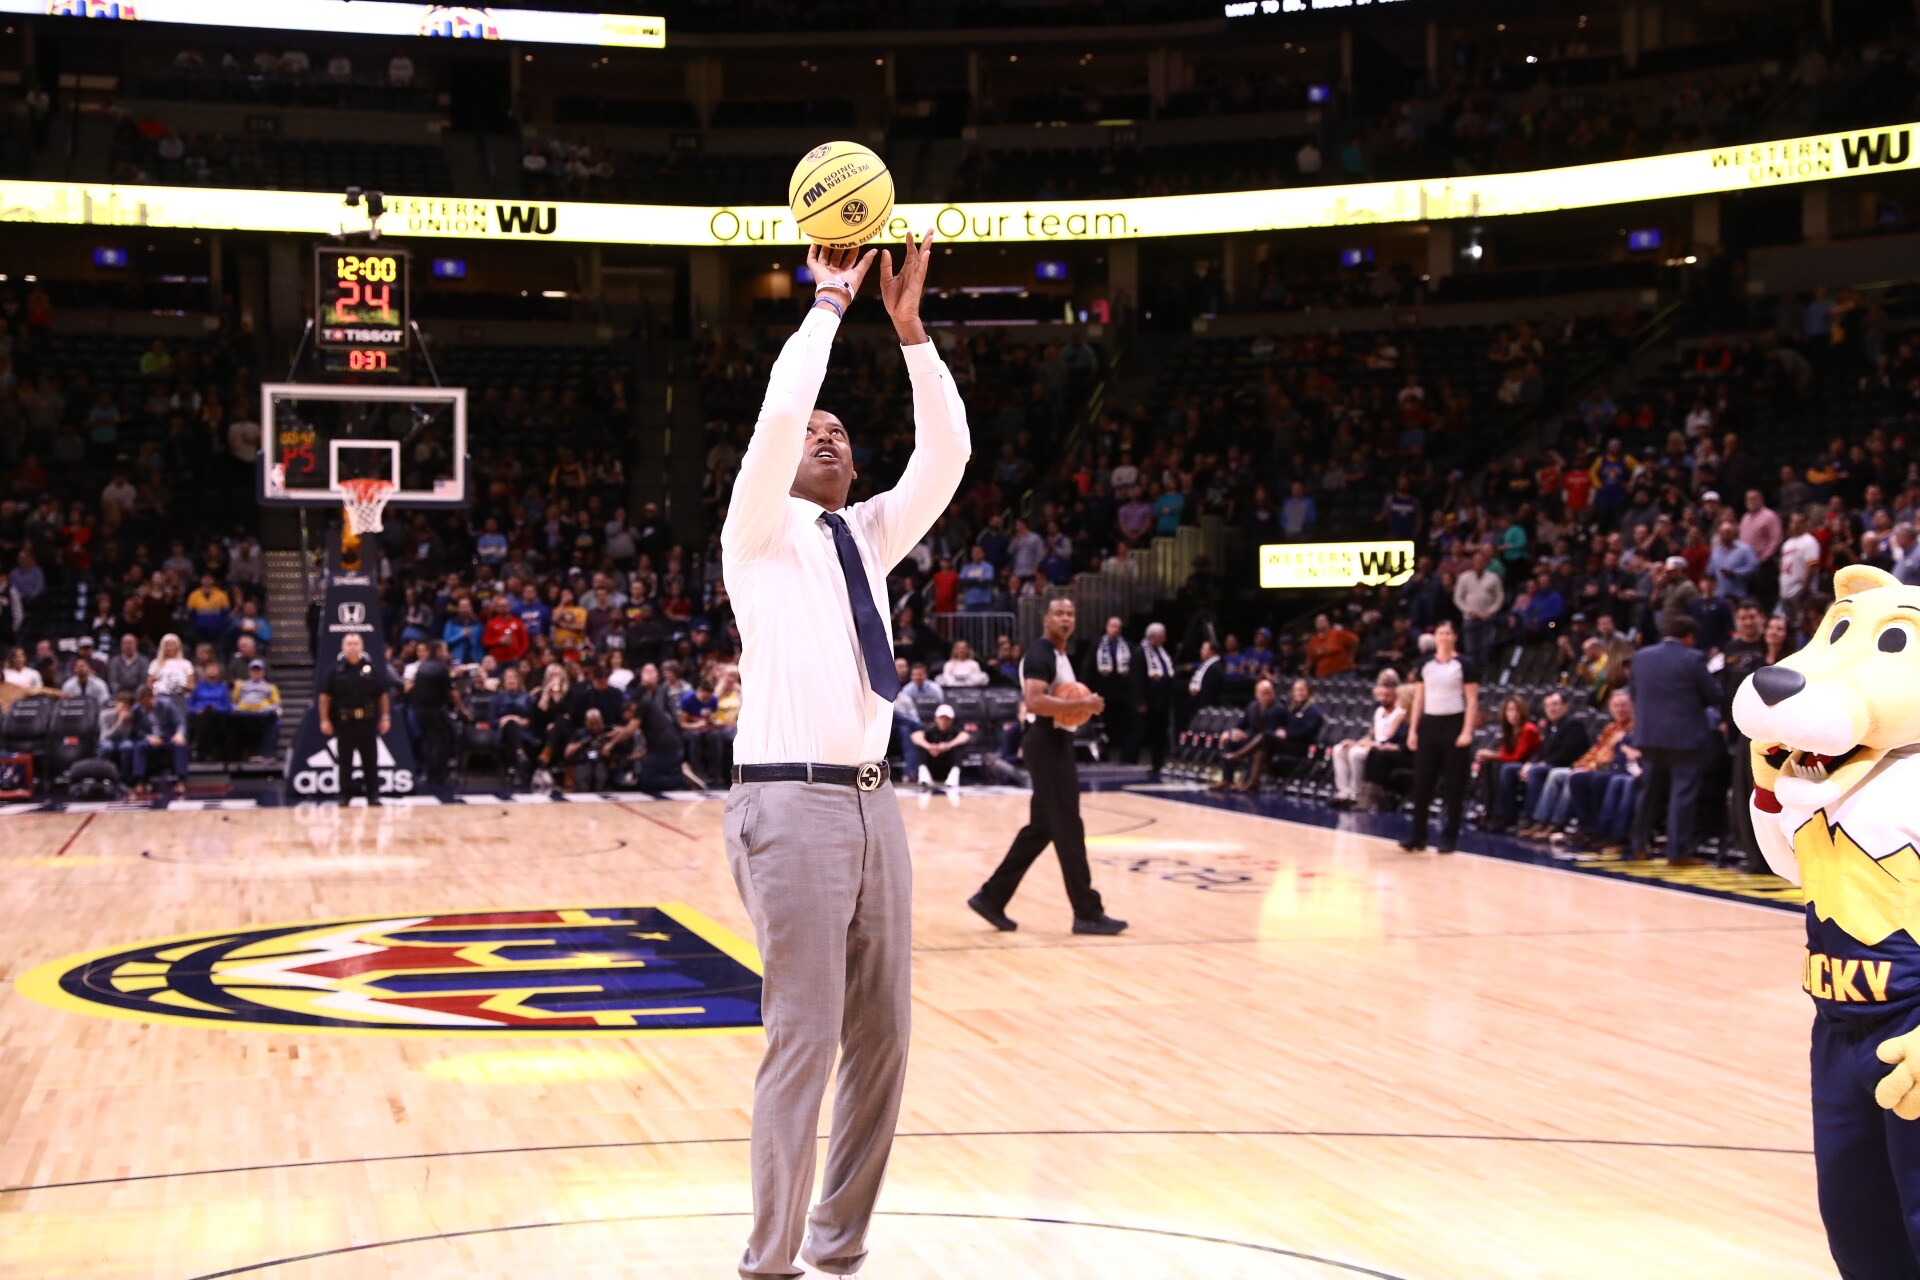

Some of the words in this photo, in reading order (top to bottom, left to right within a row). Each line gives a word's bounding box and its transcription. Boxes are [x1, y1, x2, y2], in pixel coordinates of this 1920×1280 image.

[1711, 141, 1830, 168] WESTERN
[1841, 130, 1910, 169] WU
[823, 163, 855, 183] UNION
[827, 164, 870, 189] WESTERN
[1749, 160, 1830, 182] UNION
[802, 182, 828, 208] WU
[384, 201, 487, 217] ESTERN
[496, 205, 557, 234] WU
[409, 218, 486, 233] UNION
[710, 210, 782, 241] Our
[936, 207, 1009, 238] Our
[1024, 210, 1139, 237] team.
[337, 255, 397, 283] 12:00
[335, 280, 390, 322] 24
[344, 329, 404, 342] TISSOT
[293, 764, 414, 794] adas
[1802, 948, 1892, 1002] OCKY
